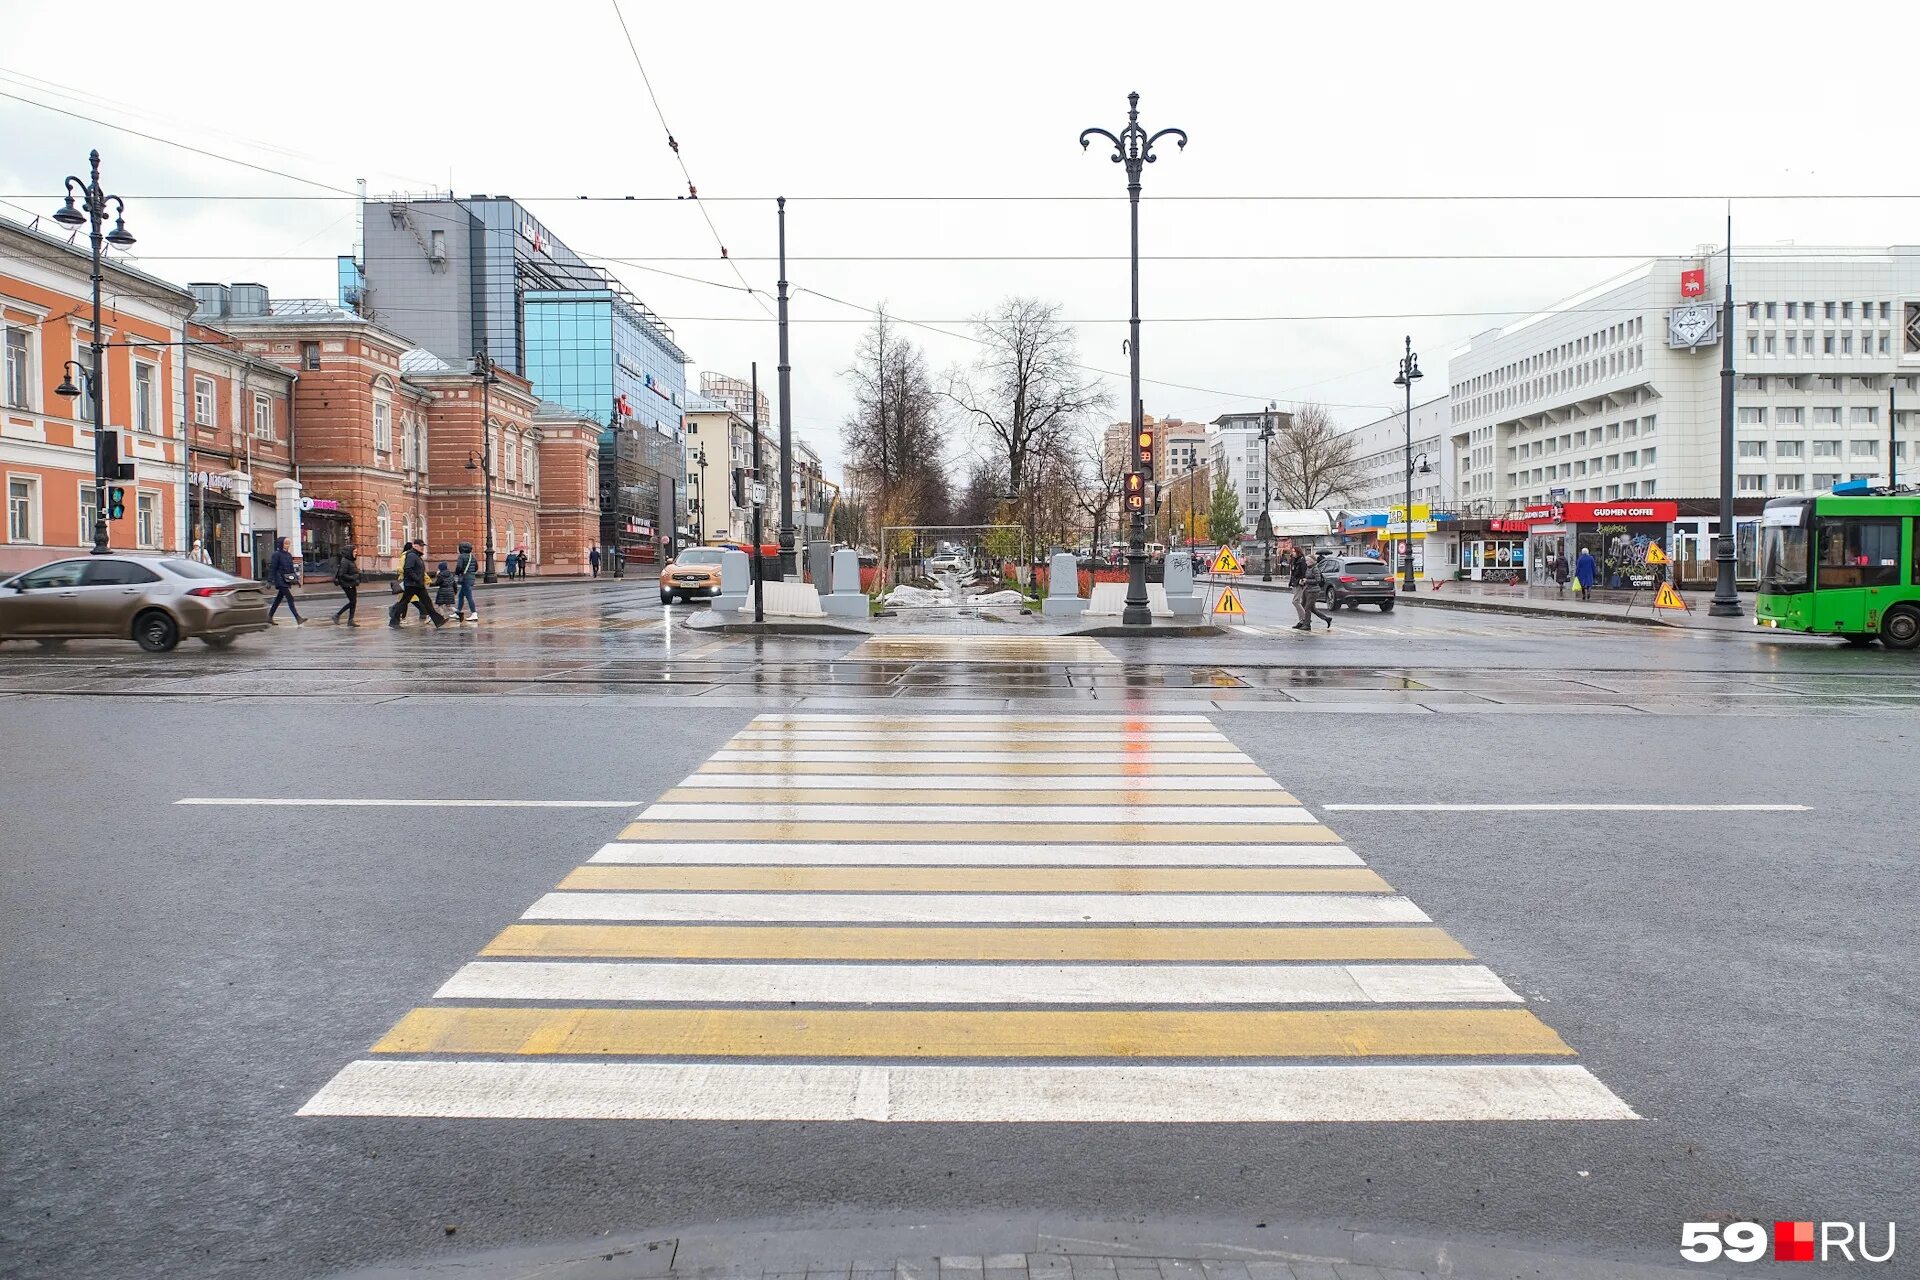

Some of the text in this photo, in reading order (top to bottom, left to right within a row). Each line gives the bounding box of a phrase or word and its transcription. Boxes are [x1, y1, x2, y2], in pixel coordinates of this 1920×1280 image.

[1129, 496, 1142, 507] 40
[1593, 508, 1654, 517] GUDMEN COFFEE
